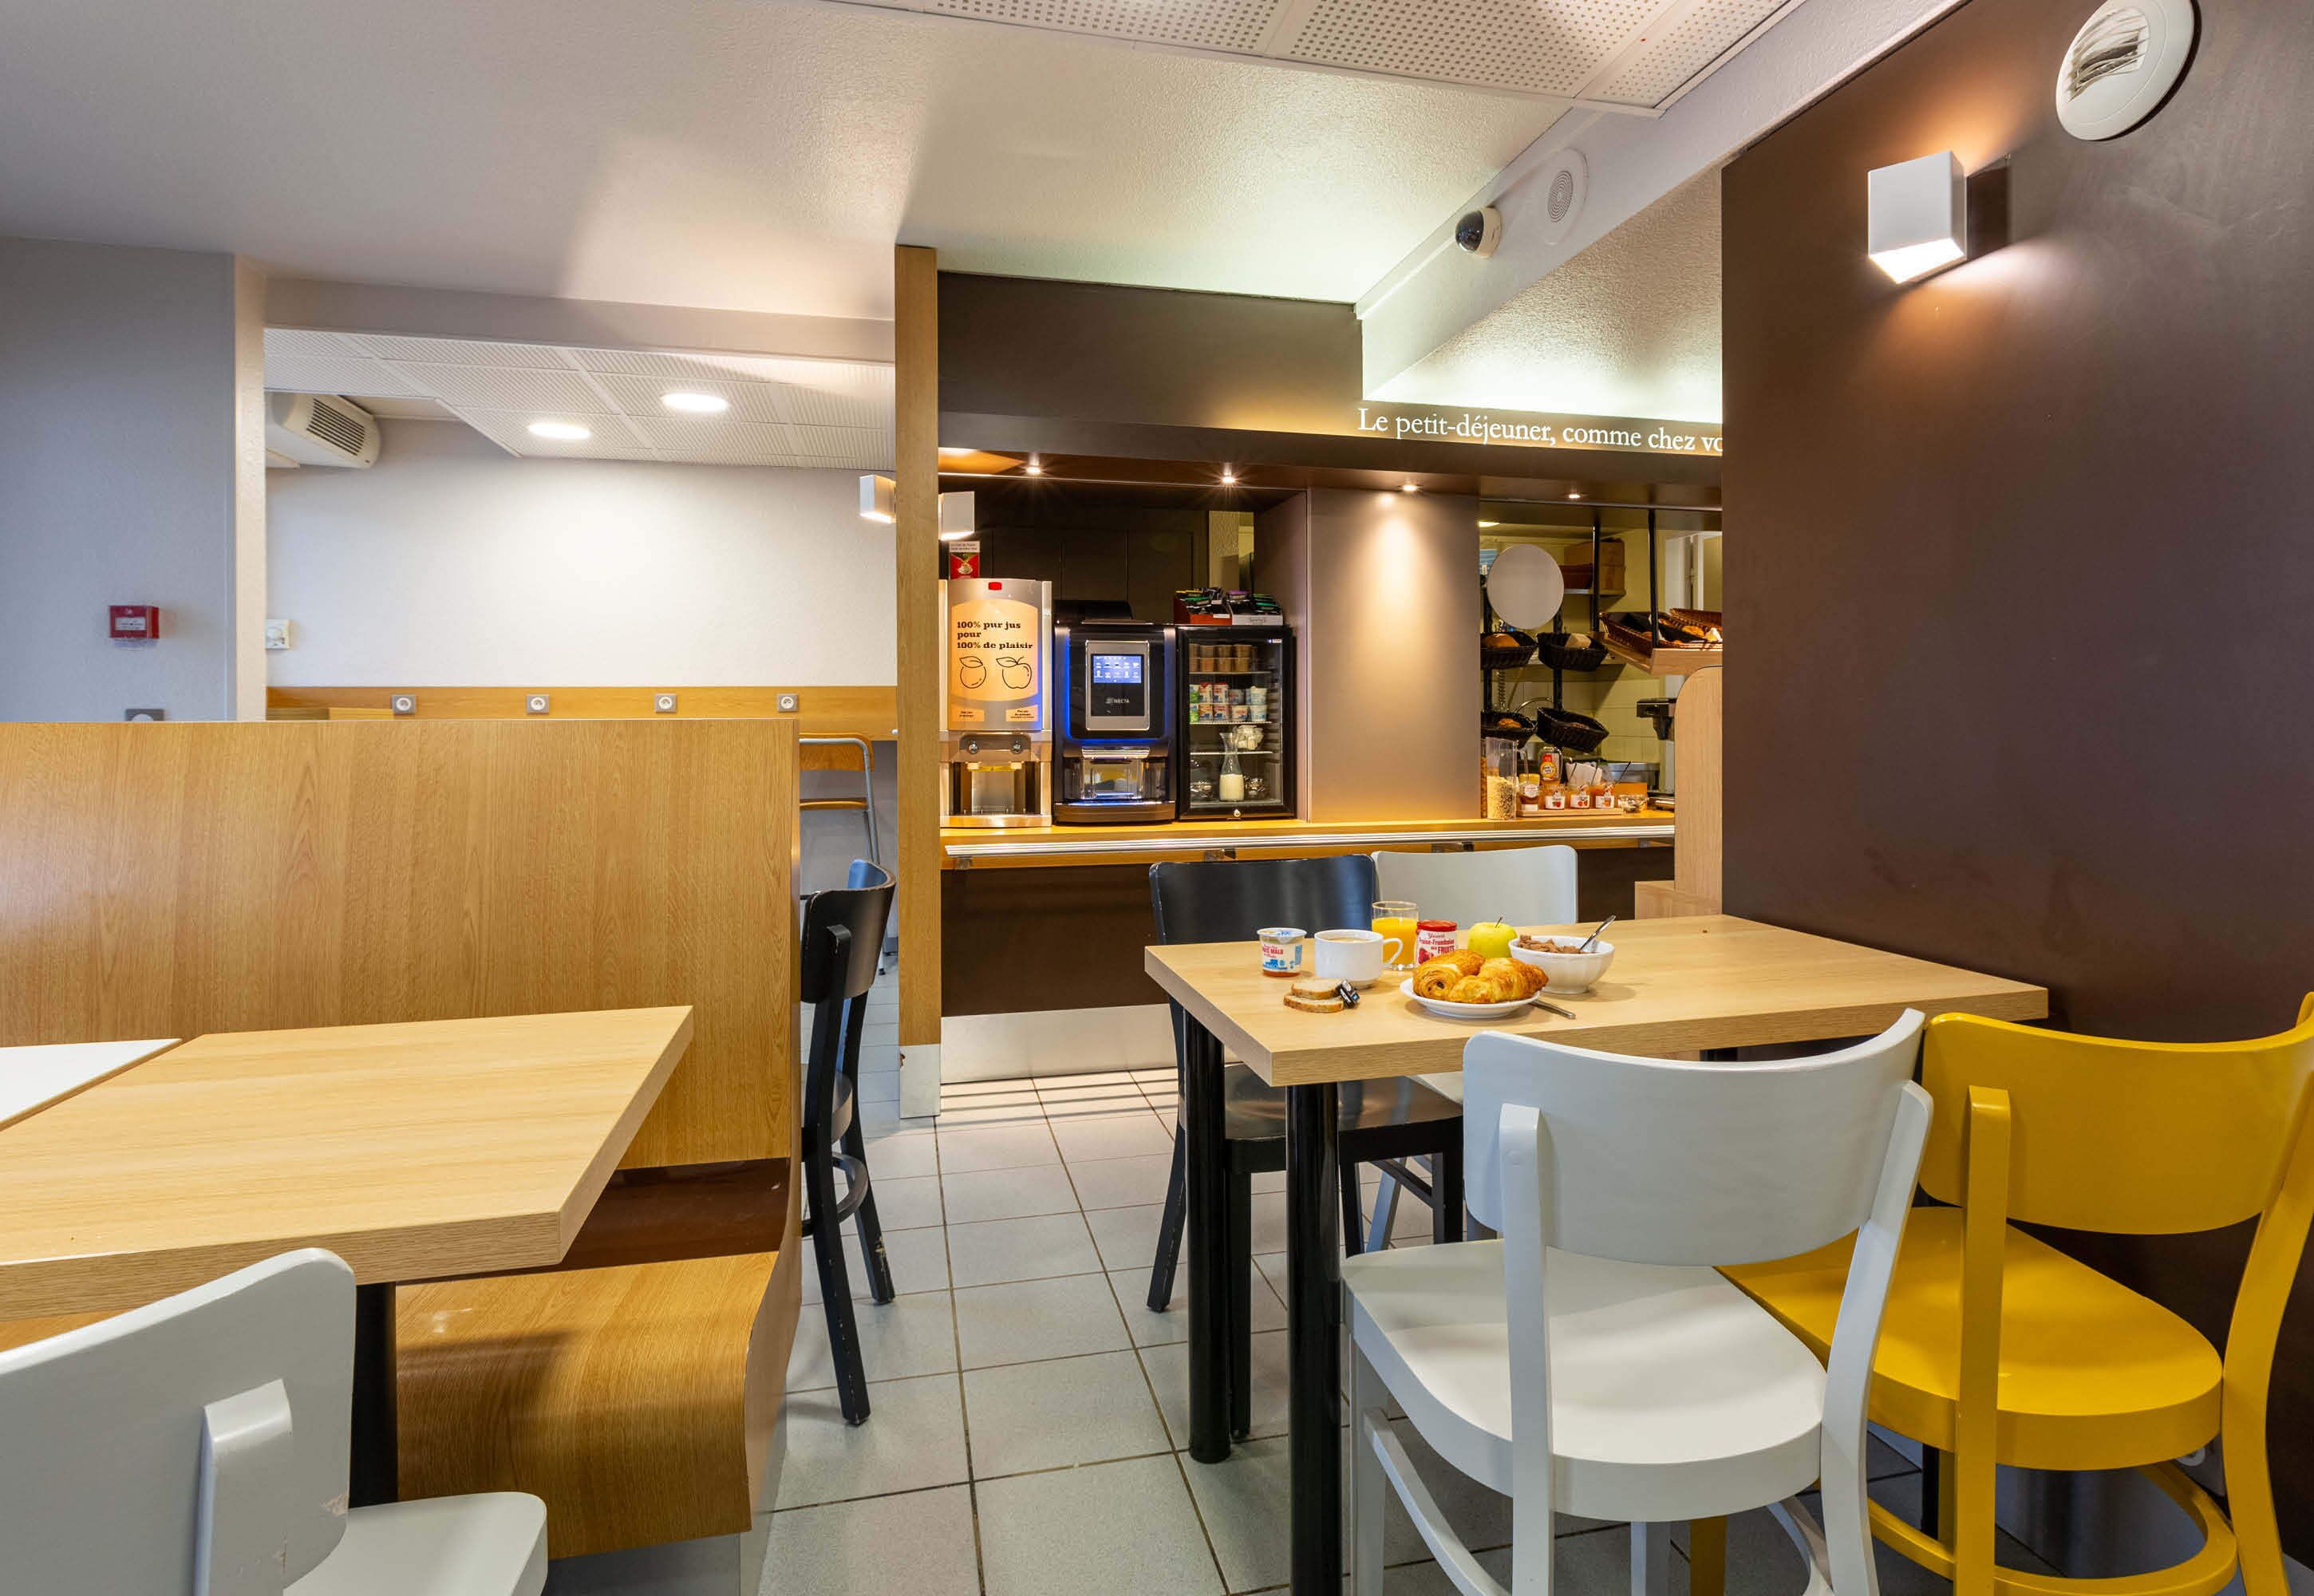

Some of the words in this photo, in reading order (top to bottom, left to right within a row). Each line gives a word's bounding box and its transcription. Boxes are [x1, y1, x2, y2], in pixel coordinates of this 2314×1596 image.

[1357, 408, 1388, 432] Le
[1395, 413, 1555, 446] petit-déjeuner,
[1562, 426, 1641, 448] comme
[1648, 427, 1695, 451] chez
[1004, 621, 1021, 630] jus
[957, 631, 982, 640] pour
[999, 642, 1033, 650] plaisir
